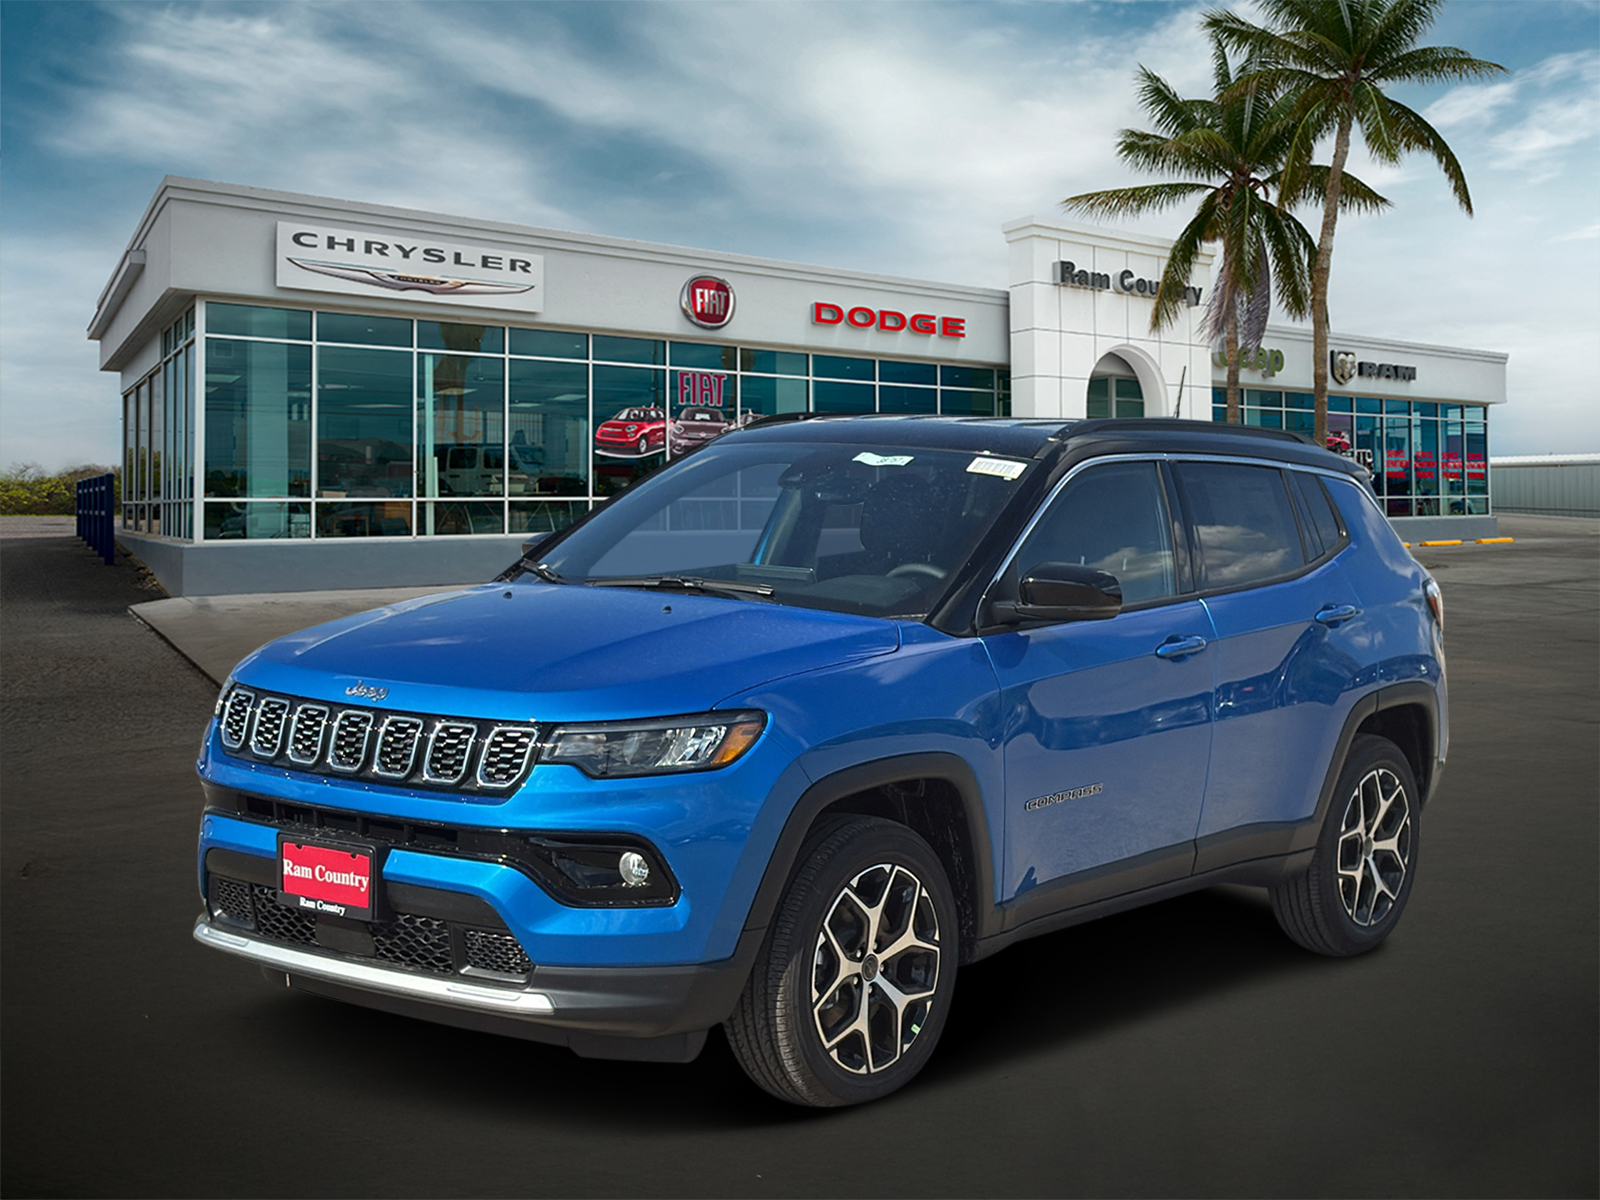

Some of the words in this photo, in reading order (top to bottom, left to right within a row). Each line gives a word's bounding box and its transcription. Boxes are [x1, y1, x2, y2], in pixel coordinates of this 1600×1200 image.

[292, 232, 532, 274] CHRYSLER
[1054, 260, 1111, 291] Ram
[1114, 269, 1203, 307] Coury
[695, 288, 728, 316] FIAT
[812, 301, 966, 339] DODGE
[1358, 361, 1417, 381] RAM
[678, 370, 727, 406] FIAT
[345, 679, 389, 702] Jeep
[1024, 782, 1104, 811] COMPASS
[283, 858, 313, 880] Ram
[314, 864, 369, 893] Country
[299, 896, 316, 909] Ram
[316, 900, 346, 917] Country
